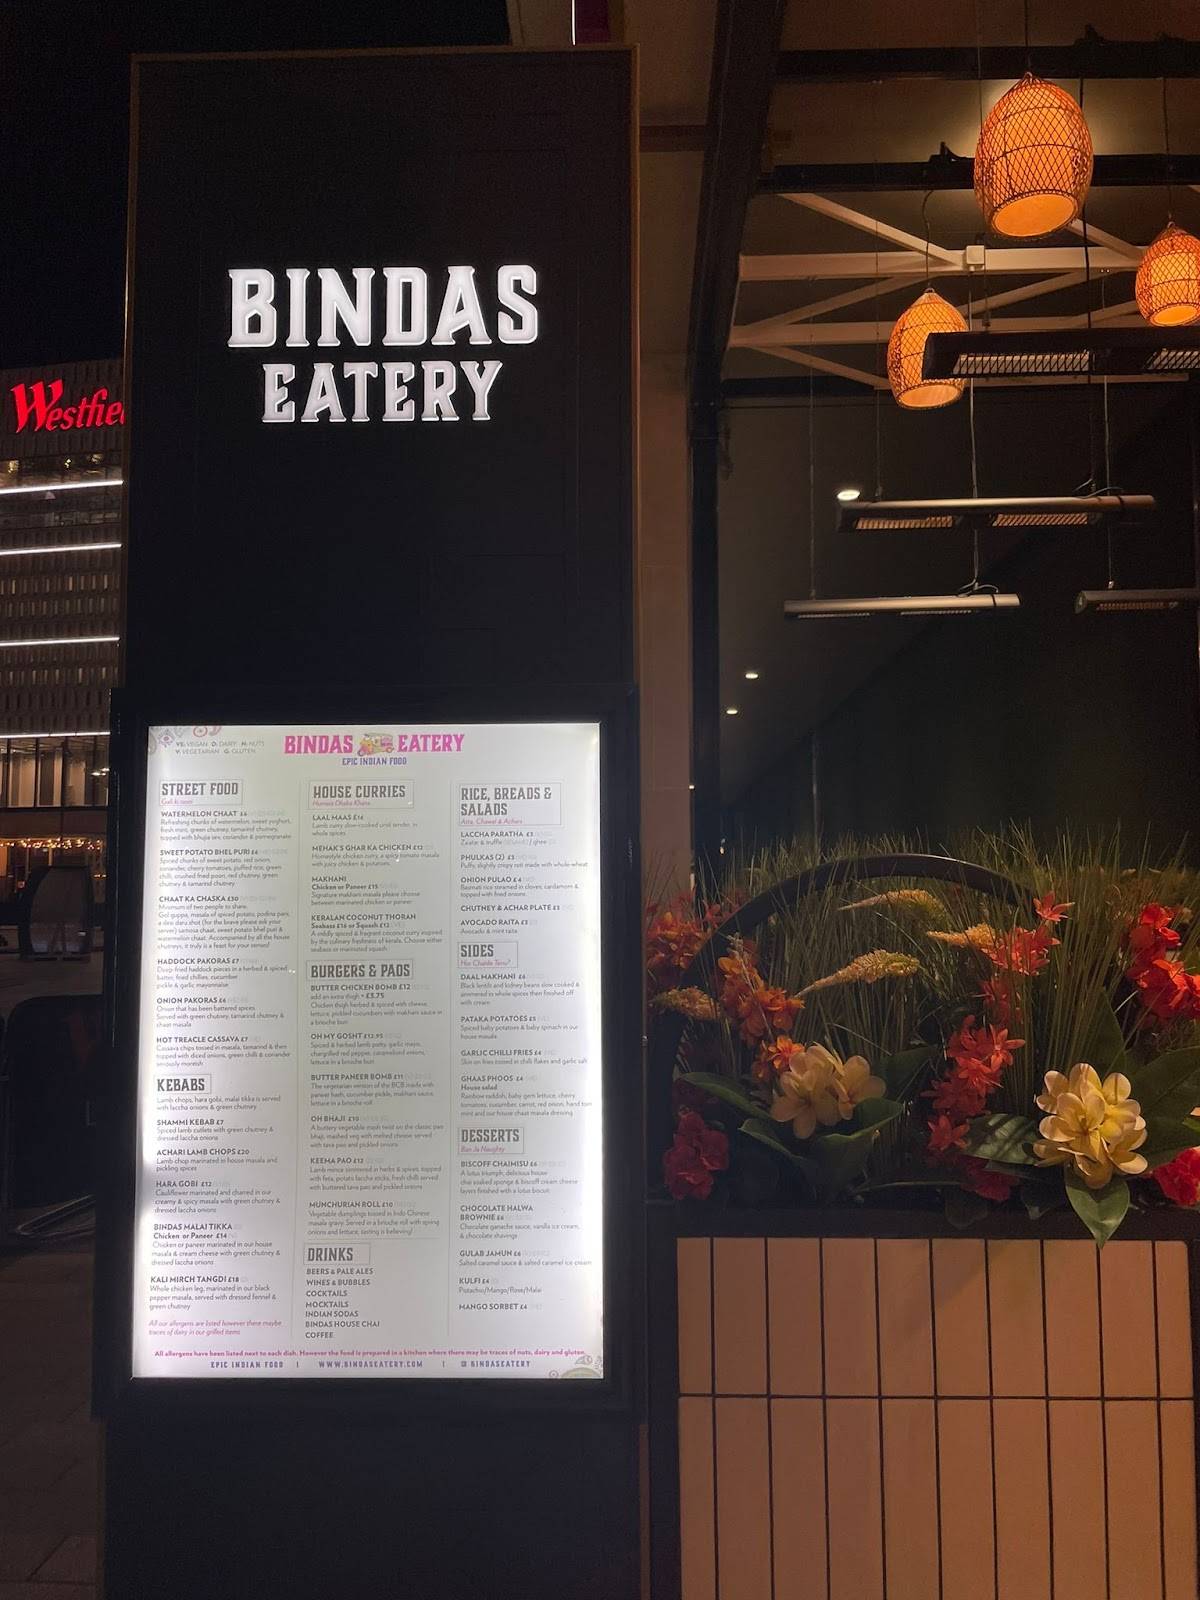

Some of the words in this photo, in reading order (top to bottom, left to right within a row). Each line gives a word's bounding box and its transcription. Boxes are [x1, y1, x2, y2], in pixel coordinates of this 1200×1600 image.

[226, 264, 540, 349] BINDAS
[261, 358, 503, 425] EATERY
[284, 734, 353, 754] BINDAS
[396, 734, 465, 754] EATERY
[341, 757, 358, 766] EPIC
[359, 757, 387, 766] INDIAN
[389, 756, 408, 765] FOOD
[161, 782, 207, 796] STREET
[210, 782, 239, 795] FOOD
[313, 785, 352, 799] HOUSE
[355, 785, 406, 798] CURRIES
[460, 787, 491, 802] RICE,
[494, 787, 541, 801] BREADS
[543, 787, 552, 800] &
[460, 802, 508, 816] SALADS
[158, 895, 184, 903] CHAAT
[460, 904, 497, 912] CHUTNEY
[460, 944, 495, 958] SIDES
[310, 964, 365, 978] BURGERS
[368, 964, 377, 978] &
[380, 963, 410, 977] PAOS
[460, 1049, 488, 1057] GARLIC
[340, 1073, 369, 1081] PANEER
[157, 1078, 205, 1092] KEBABS
[461, 1129, 520, 1143] DESSERTS
[186, 1148, 208, 1156] LAMB
[209, 1148, 236, 1156] CHOPS
[460, 1160, 492, 1168] BISCOFF
[492, 1160, 529, 1168] CHAIMISU
[178, 1180, 198, 1188] GOBI
[460, 1204, 506, 1212] CHOCOLATE
[506, 1204, 534, 1212] HALWA
[153, 1232, 180, 1240] Chicken
[190, 1232, 214, 1240] Paneer
[307, 1247, 354, 1262] DRINKS
[485, 1249, 513, 1257] JAMUN
[458, 1277, 481, 1285] KULFI
[305, 1301, 349, 1309] MOCKTAILS
[305, 1310, 333, 1318] INDIAN
[333, 1310, 359, 1318] SODAS
[334, 1320, 360, 1328] HOUSE
[361, 1320, 380, 1328] CHAI
[304, 1331, 334, 1339] COFFEE
